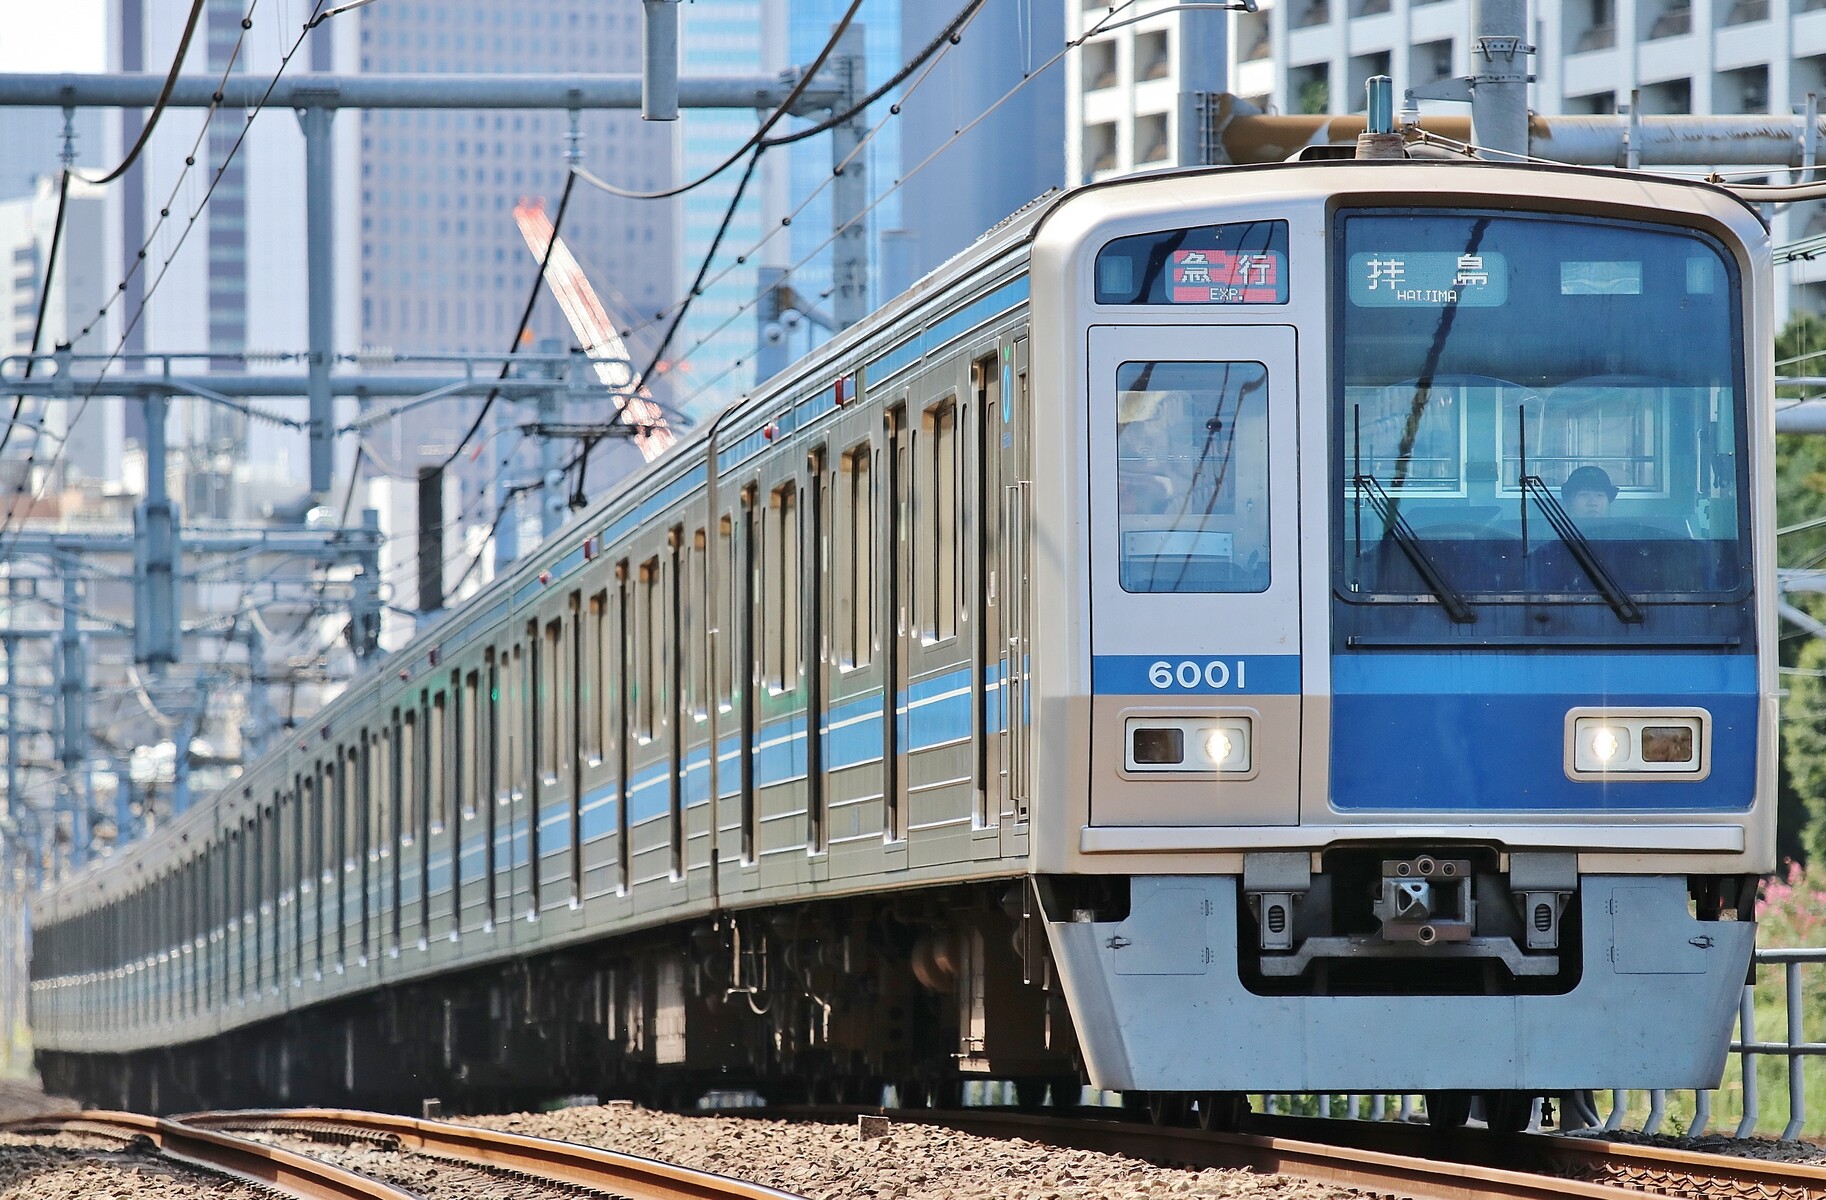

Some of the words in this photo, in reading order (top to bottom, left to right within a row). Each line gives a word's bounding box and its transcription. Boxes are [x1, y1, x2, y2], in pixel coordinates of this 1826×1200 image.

[1180, 252, 1271, 285] 急行
[1210, 288, 1244, 300] EXP.
[1397, 290, 1457, 302] HAIJIMA
[1148, 660, 1245, 689] 6001
